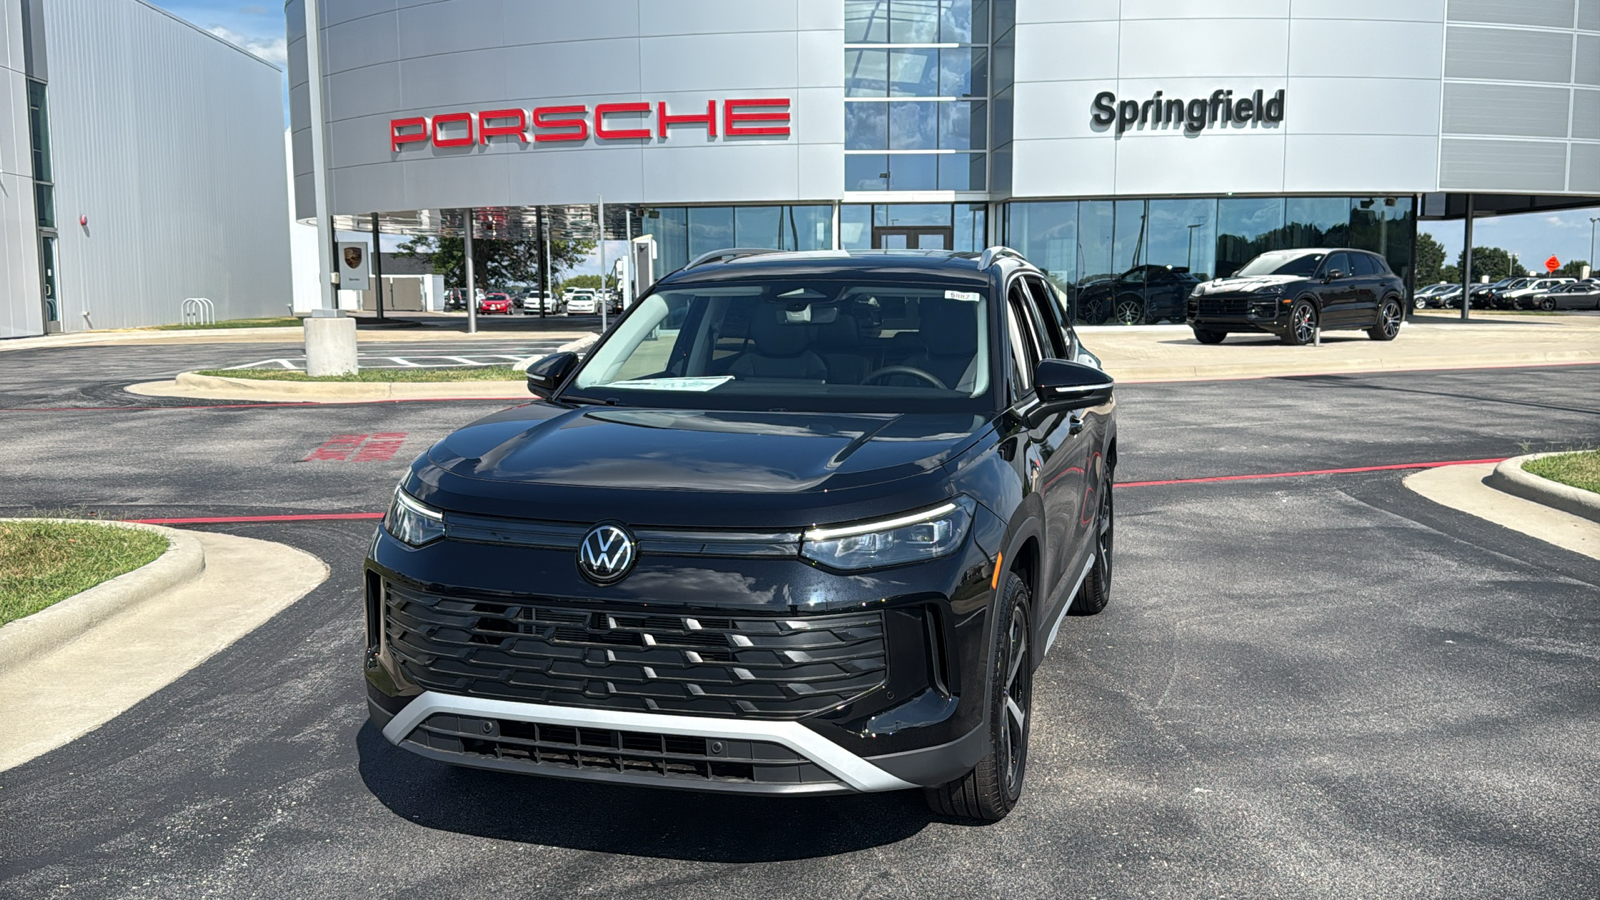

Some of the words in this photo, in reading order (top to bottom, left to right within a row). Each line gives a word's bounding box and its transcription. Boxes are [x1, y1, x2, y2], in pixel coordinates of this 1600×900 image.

[390, 98, 791, 153] PORSCHE
[1092, 88, 1286, 134] Springfield
[582, 526, 631, 576] VW
